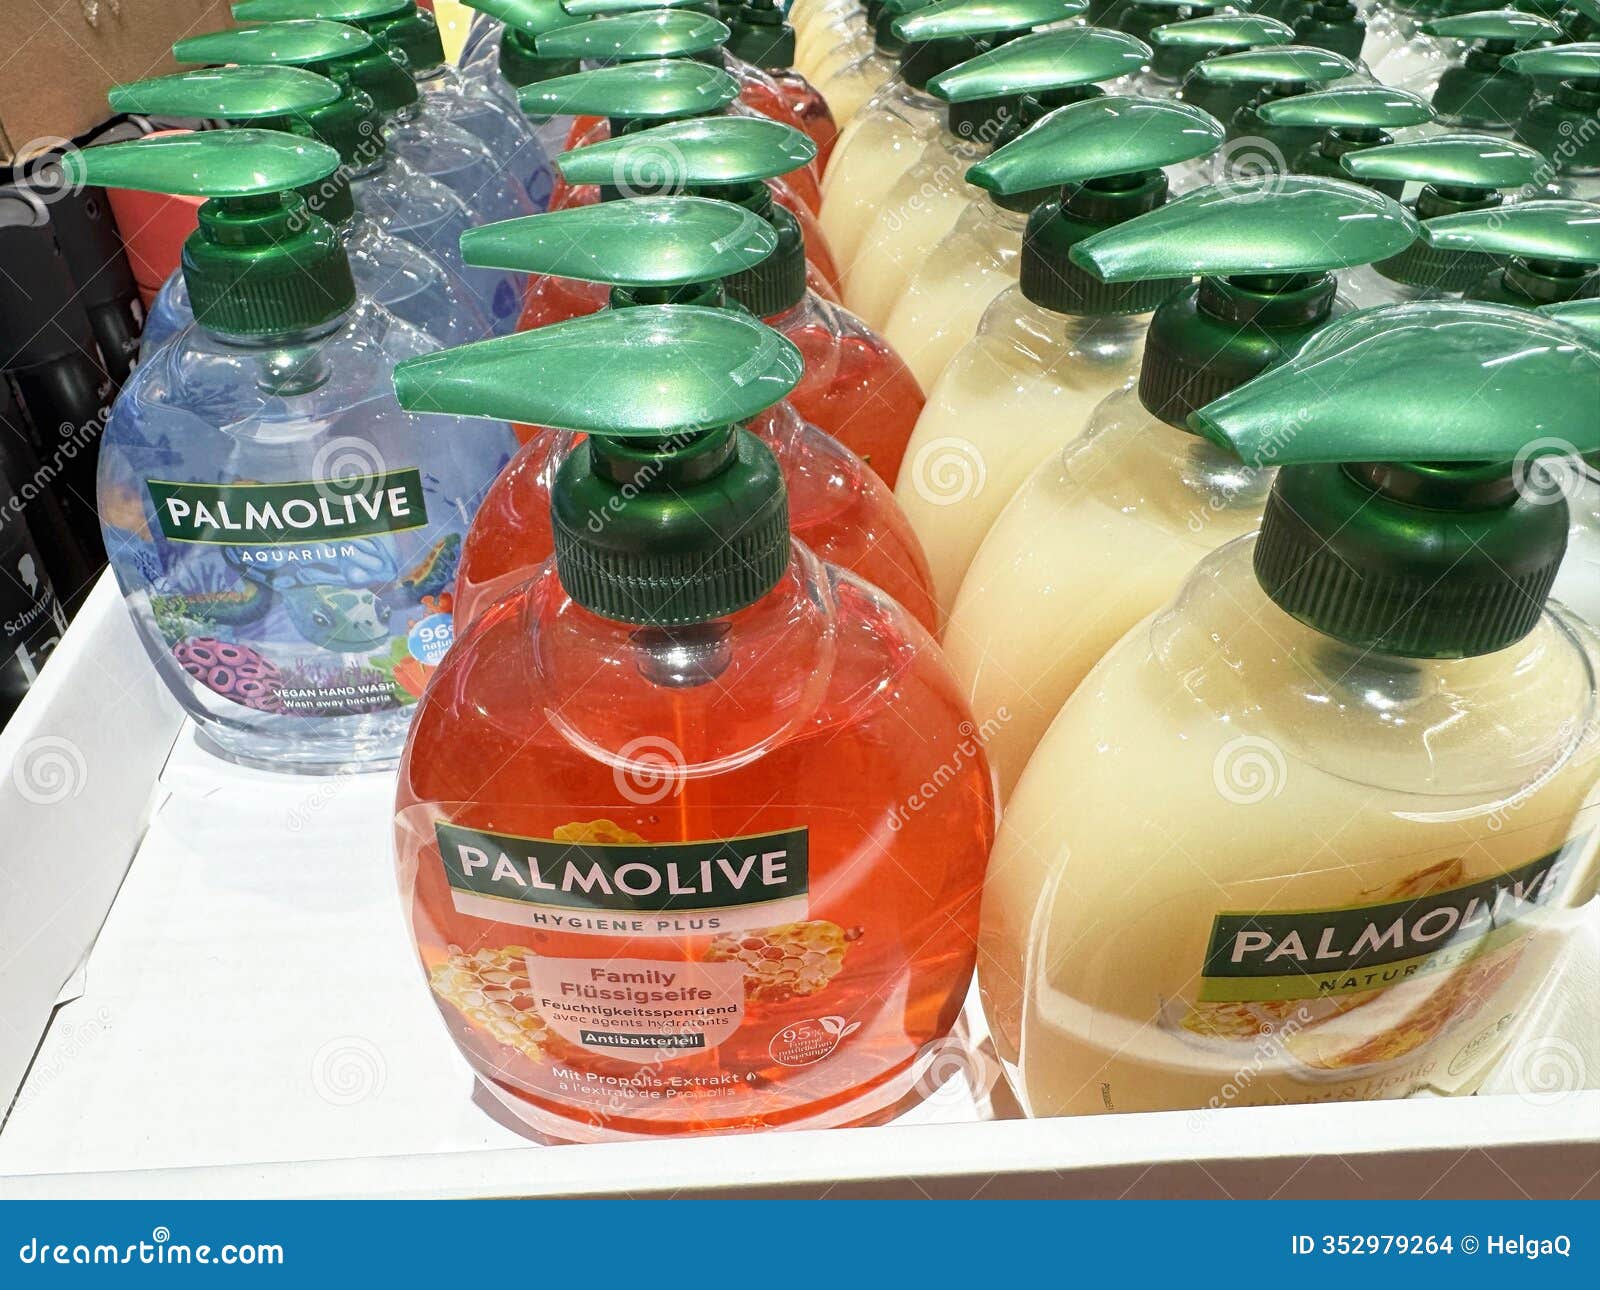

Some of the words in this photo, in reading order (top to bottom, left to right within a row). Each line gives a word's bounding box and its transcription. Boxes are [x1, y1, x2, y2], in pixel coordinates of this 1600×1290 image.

[166, 487, 410, 529] PALMOLIVE
[242, 546, 355, 561] AQUARIUM
[273, 688, 317, 699] VEGAN
[319, 687, 355, 697] HAND
[358, 682, 396, 694] WASH
[283, 699, 313, 708] Wash
[316, 700, 344, 711] away
[346, 694, 392, 706] bacteria
[457, 845, 788, 895] PALMOLIVE
[1231, 860, 1566, 963] PALMOLIVE
[533, 912, 643, 931] HYGIENE
[657, 917, 721, 931] PLUS
[591, 967, 676, 987] Family
[560, 982, 712, 1004] Flüssigseife
[541, 999, 738, 1018] Feuchtigkeitsspendend
[553, 1013, 586, 1024] avec
[592, 1017, 643, 1028] agents
[648, 1016, 729, 1028] hydratants
[584, 1033, 699, 1047] Antibakteriell
[552, 1067, 581, 1082] Mit
[587, 1071, 739, 1088] Propolis-Extrakt
[639, 1089, 661, 1099] de
[666, 1087, 735, 1099] Propolis
